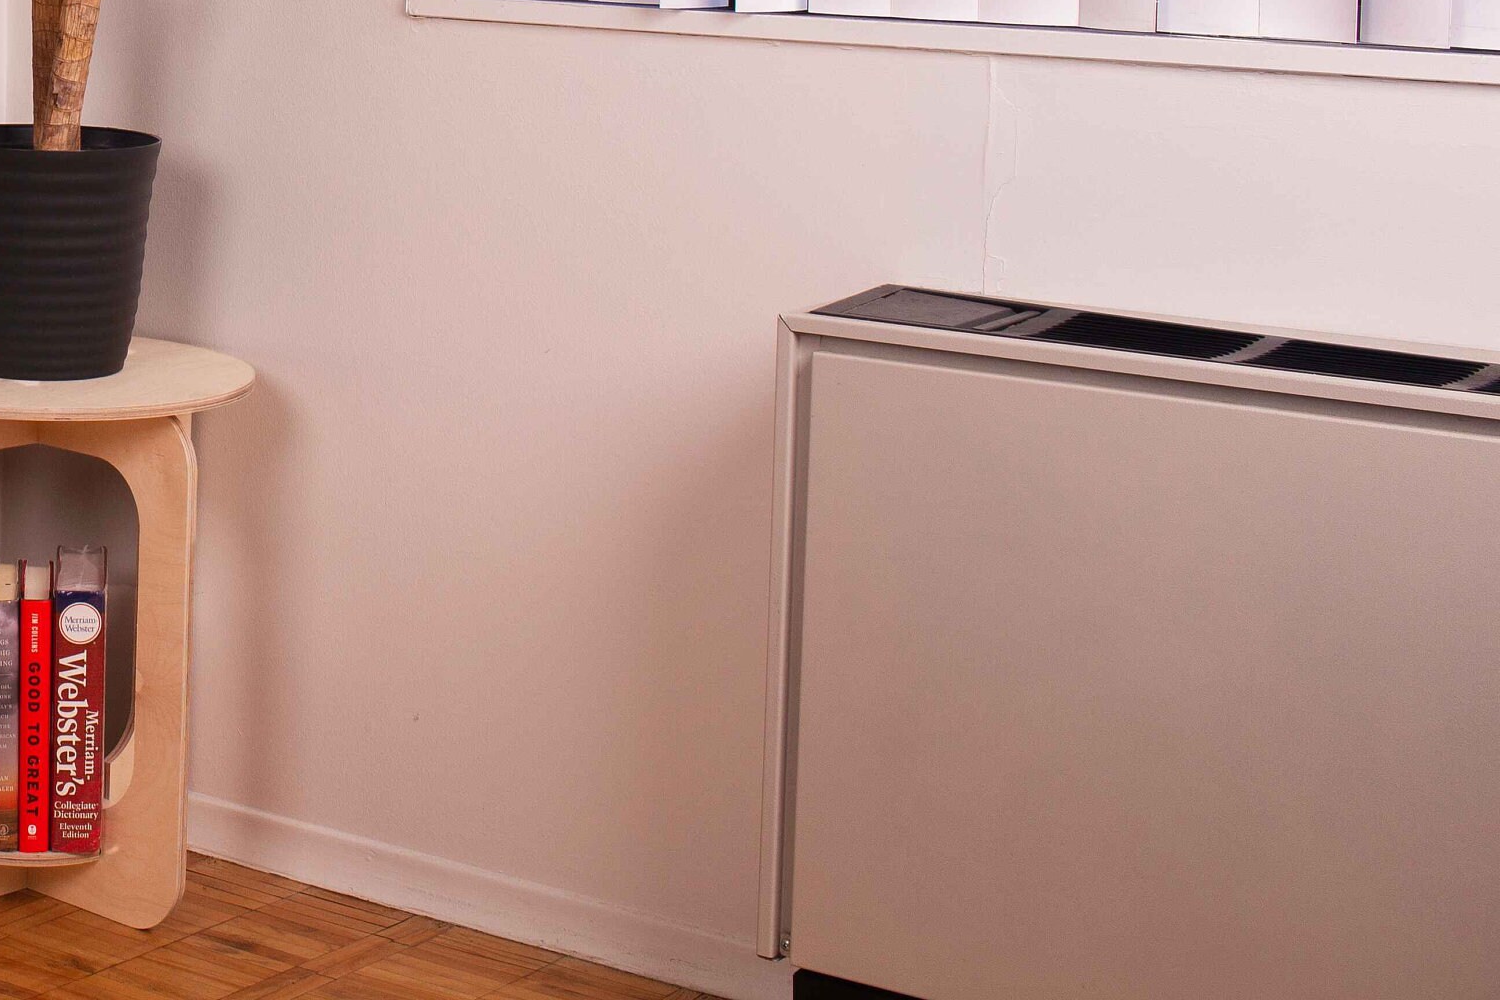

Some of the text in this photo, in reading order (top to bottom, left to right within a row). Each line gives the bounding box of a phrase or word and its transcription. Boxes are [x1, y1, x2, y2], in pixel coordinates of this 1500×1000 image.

[30, 626, 38, 653] COLLINS
[65, 624, 95, 632] Webster
[26, 662, 40, 817] GOOD TO GREAT
[56, 649, 88, 796] Webster's
[84, 710, 99, 780] Merriam-
[54, 810, 98, 820] Dictionary
